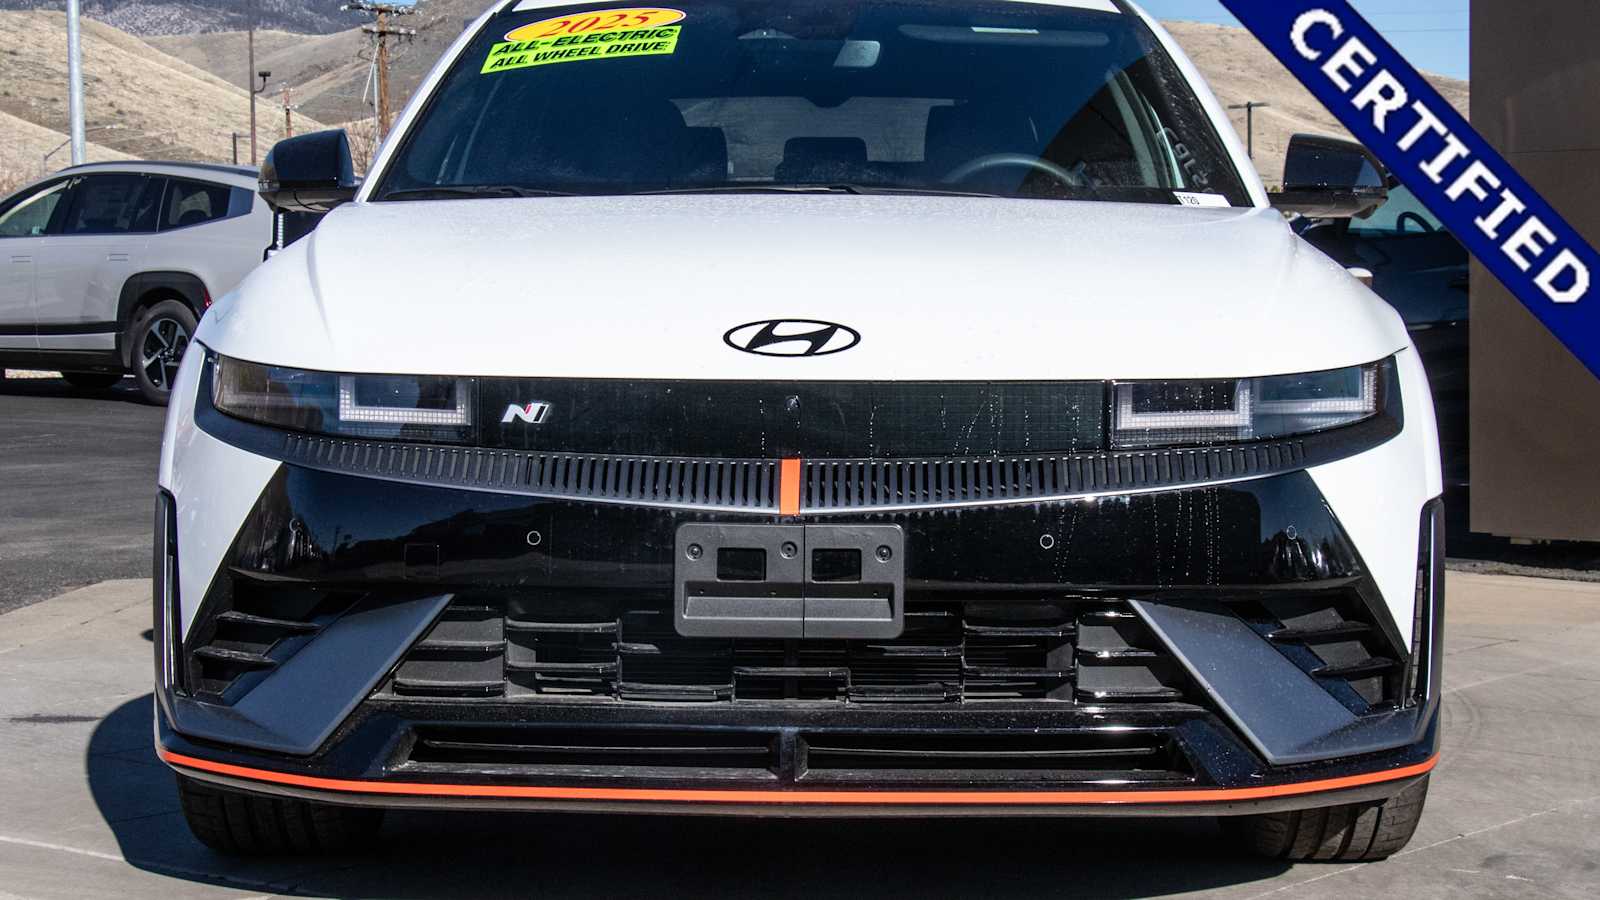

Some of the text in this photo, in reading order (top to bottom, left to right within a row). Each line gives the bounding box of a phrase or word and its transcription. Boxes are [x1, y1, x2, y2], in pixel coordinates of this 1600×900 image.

[536, 11, 660, 38] 2025
[490, 41, 671, 69] ALL WHEEL DRIVE
[493, 28, 677, 56] ALL-ELECTRIC
